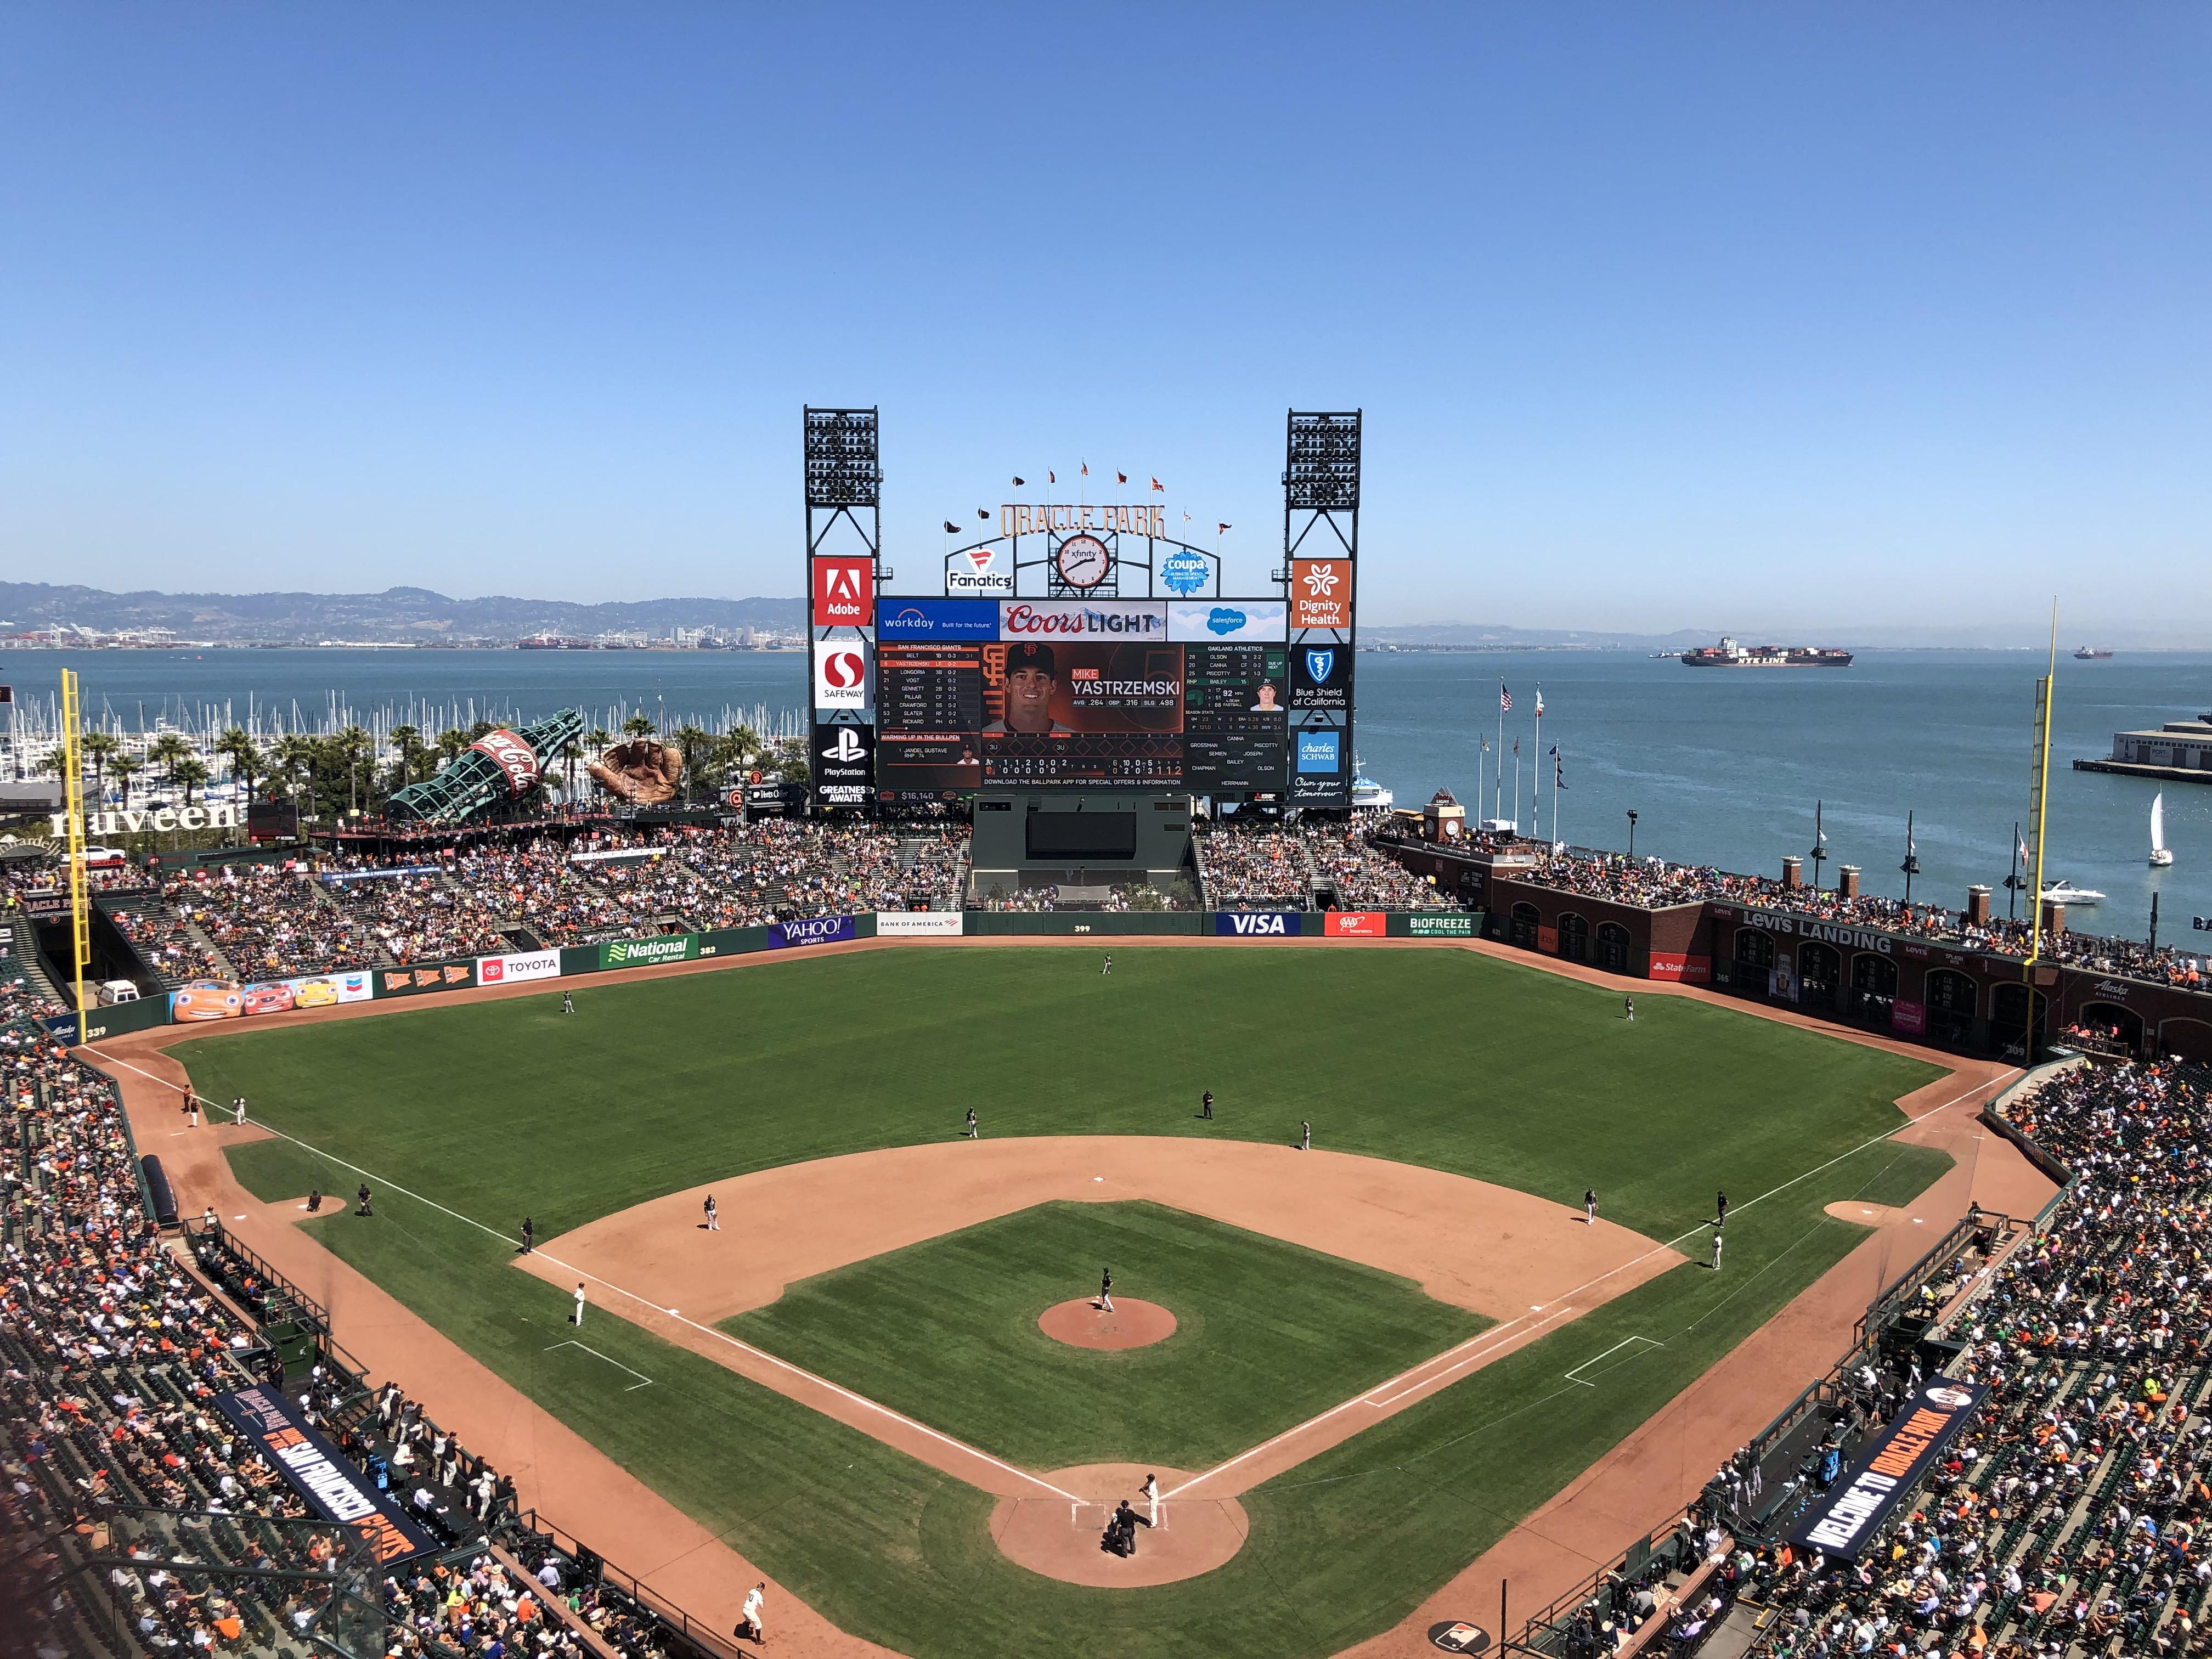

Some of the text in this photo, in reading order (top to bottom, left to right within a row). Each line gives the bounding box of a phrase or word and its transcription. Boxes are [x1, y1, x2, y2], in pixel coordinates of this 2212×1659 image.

[1001, 504, 1165, 540] ORACLE PARK
[1071, 550, 1097, 558] xfinity
[1167, 560, 1205, 572] coupa
[950, 573, 1012, 586] Fanatics
[827, 603, 860, 614] Adobe
[1299, 600, 1342, 613] Dignity
[885, 617, 934, 629] workday
[1006, 605, 1154, 633] Coors LIGHT
[1073, 669, 1098, 679] MIKE
[825, 690, 864, 698] SAFEWAY
[1071, 681, 1180, 696] YASTRZEMSKI
[1296, 688, 1342, 696] Blue Shield
[1293, 697, 1346, 706] of California
[1302, 742, 1335, 753] charles
[825, 768, 866, 777] PlayStation
[819, 786, 871, 794] GREATNESS
[1295, 777, 1341, 791] Own your
[901, 791, 934, 800] $16,140
[50, 804, 239, 837] nuveen
[24, 899, 60, 912] RACLE
[1228, 915, 1285, 933] VISA
[1340, 917, 1357, 927] AAA
[783, 918, 841, 940] YAHOO!
[800, 936, 825, 945] SPORTS
[1539, 934, 1556, 945] ebay
[1799, 921, 1891, 954] LANDING
[627, 938, 689, 959] National
[699, 946, 716, 955] 382
[662, 952, 685, 962] Rental
[1945, 952, 1963, 962] SPLASH
[508, 959, 556, 973] TOYOTA
[1716, 973, 1729, 983] 365
[2094, 980, 2129, 996] Alaska
[87, 1026, 106, 1038] 339
[2007, 1044, 2025, 1056] 309
[262, 1409, 291, 1431] PARK
[1805, 1407, 1952, 1549] WELCOME TO ORACLE PARK
[276, 1442, 415, 1560] SAN FRANCISCO GIANTS
